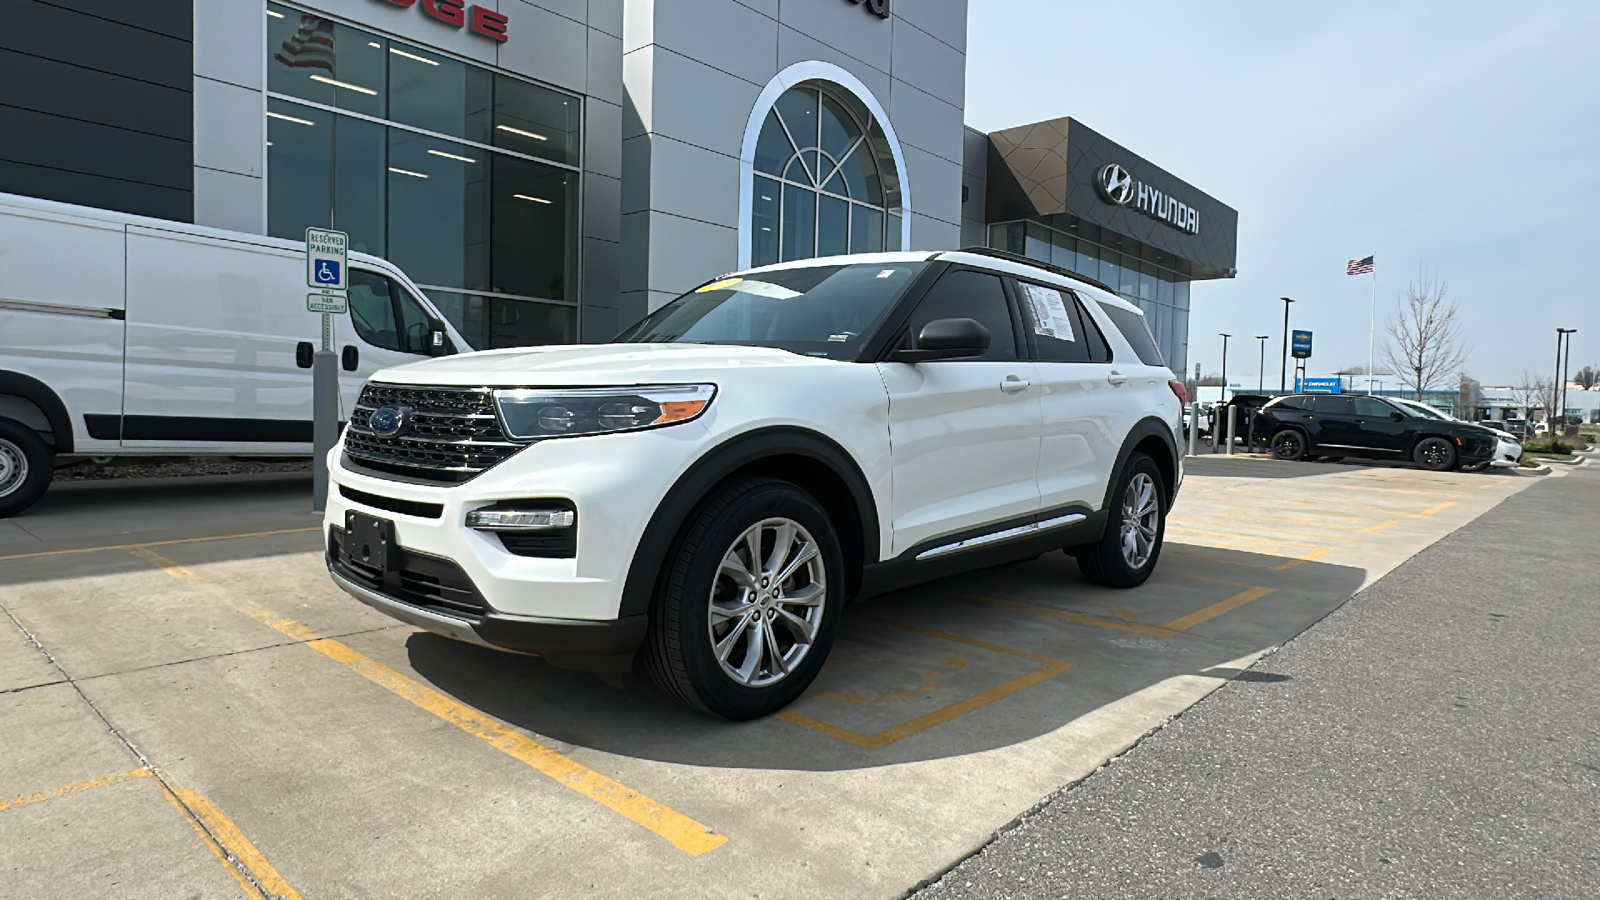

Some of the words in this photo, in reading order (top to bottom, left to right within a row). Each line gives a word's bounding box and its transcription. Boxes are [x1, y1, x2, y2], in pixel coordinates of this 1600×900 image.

[386, 0, 508, 43] GE
[1137, 181, 1200, 234] HYUNDAI
[311, 233, 344, 246] RESERVED
[310, 243, 344, 256] PARKING
[321, 296, 334, 304] VAN
[310, 302, 345, 312] ACCESSIBLE
